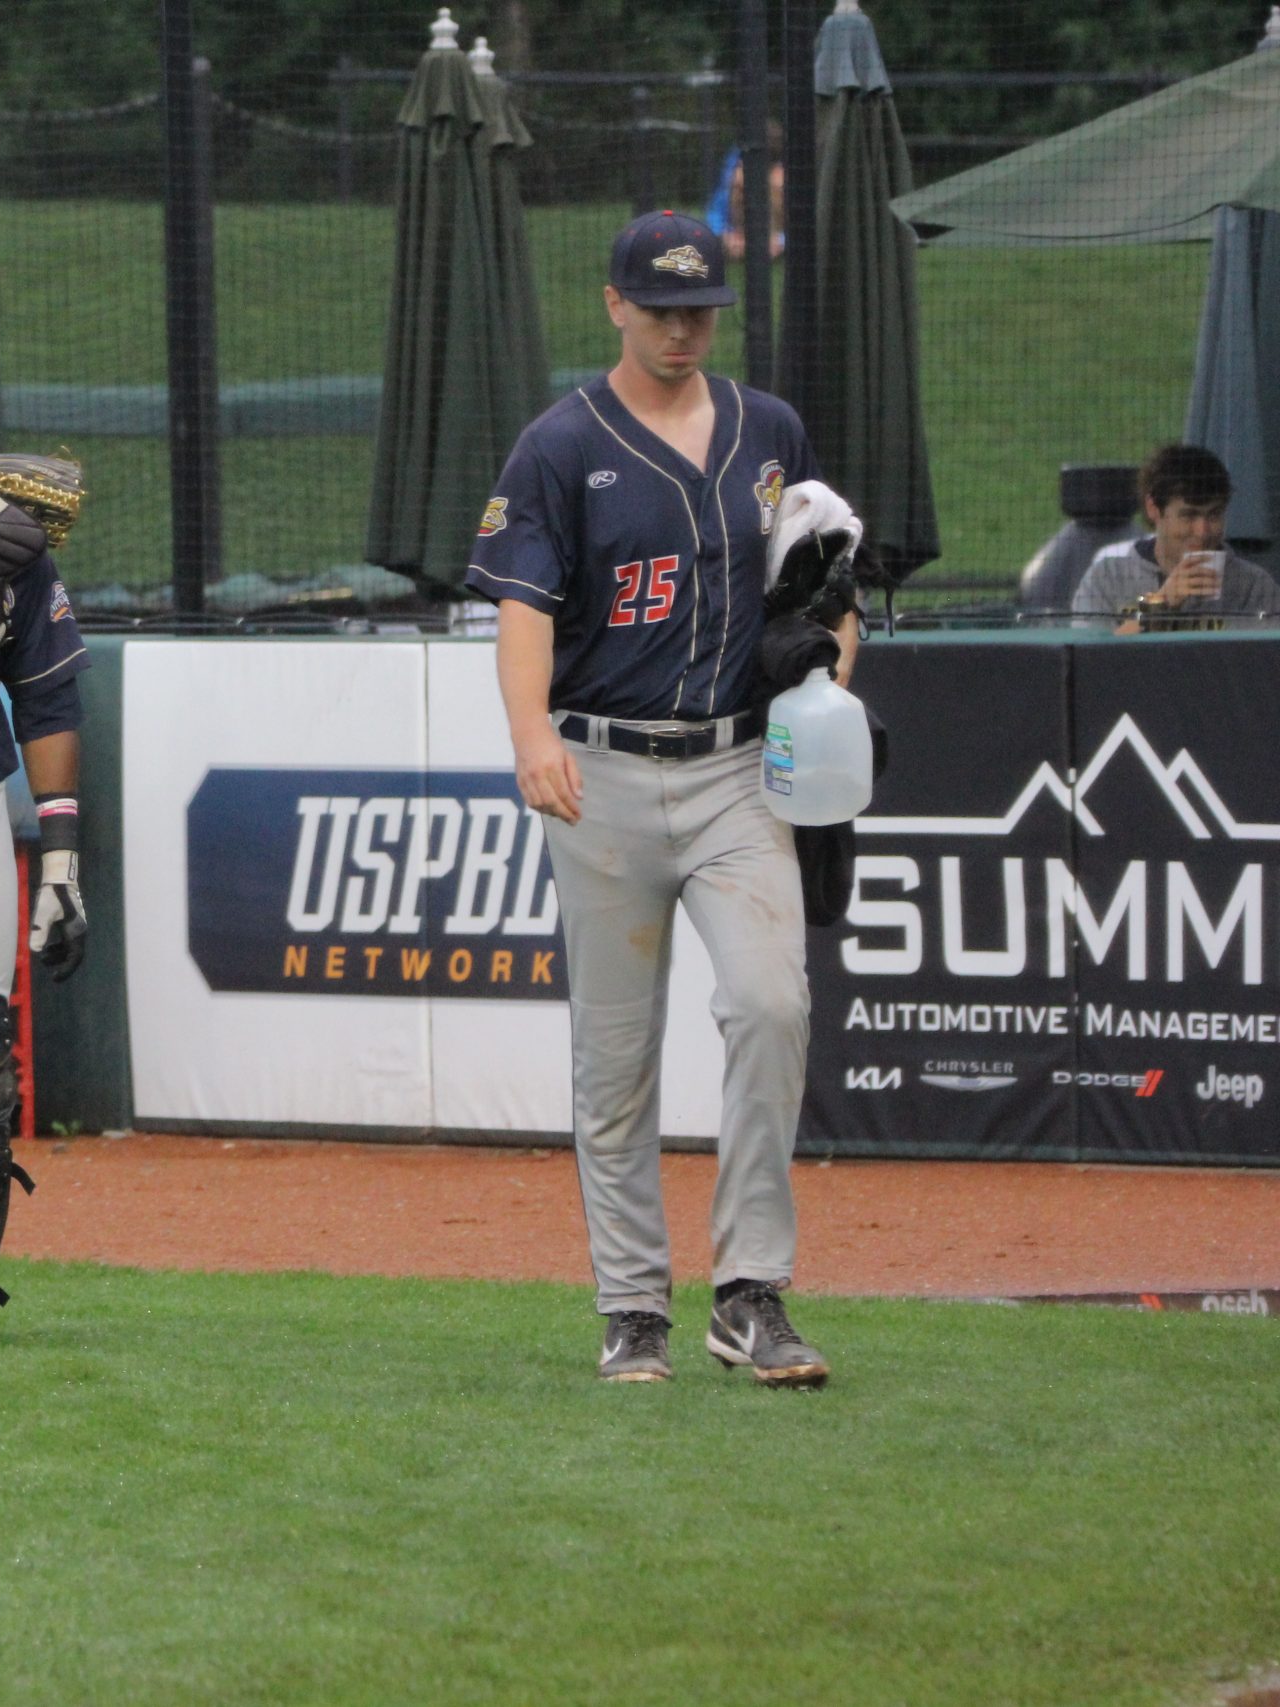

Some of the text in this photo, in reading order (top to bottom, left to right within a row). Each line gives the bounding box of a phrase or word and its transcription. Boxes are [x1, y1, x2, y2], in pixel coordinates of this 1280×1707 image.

[608, 555, 679, 627] 25
[286, 796, 560, 935] USPBL
[840, 855, 1263, 985] SUMM
[283, 945, 556, 984] NETWORK
[845, 997, 1069, 1036] AUTOMOTIVE
[846, 1066, 902, 1090] KIA
[924, 1060, 1014, 1074] CHRYSLER
[1052, 1070, 1149, 1088] DODGE
[1196, 1064, 1264, 1108] Jeep
